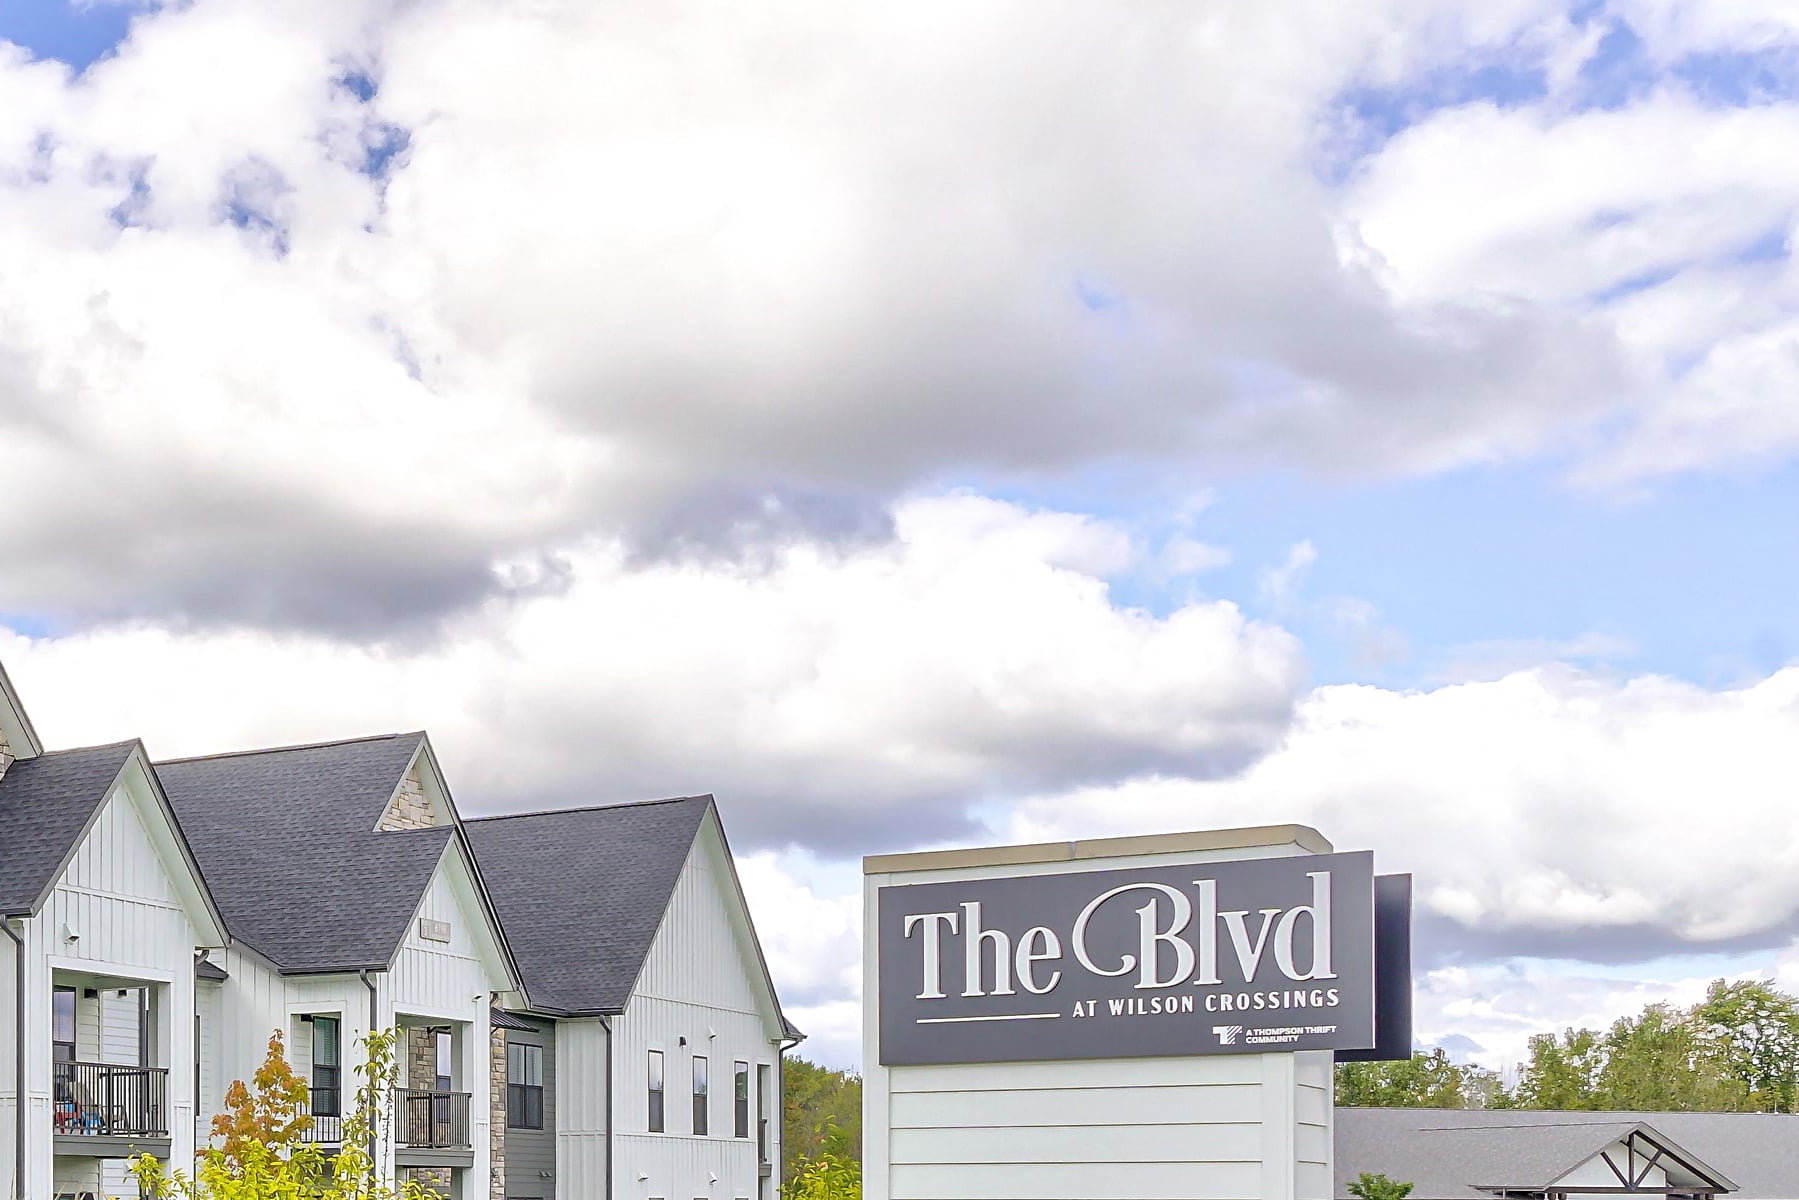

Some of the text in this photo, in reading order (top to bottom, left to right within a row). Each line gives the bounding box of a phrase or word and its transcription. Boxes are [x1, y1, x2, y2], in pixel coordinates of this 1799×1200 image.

[904, 870, 1338, 1000] The Blvd
[1072, 988, 1340, 1018] AT WILSON CROSSINGS
[1245, 1034, 1300, 1044] COMMUNITY
[1253, 1026, 1304, 1036] THOMPSON
[1304, 1025, 1337, 1034] THRIFT
